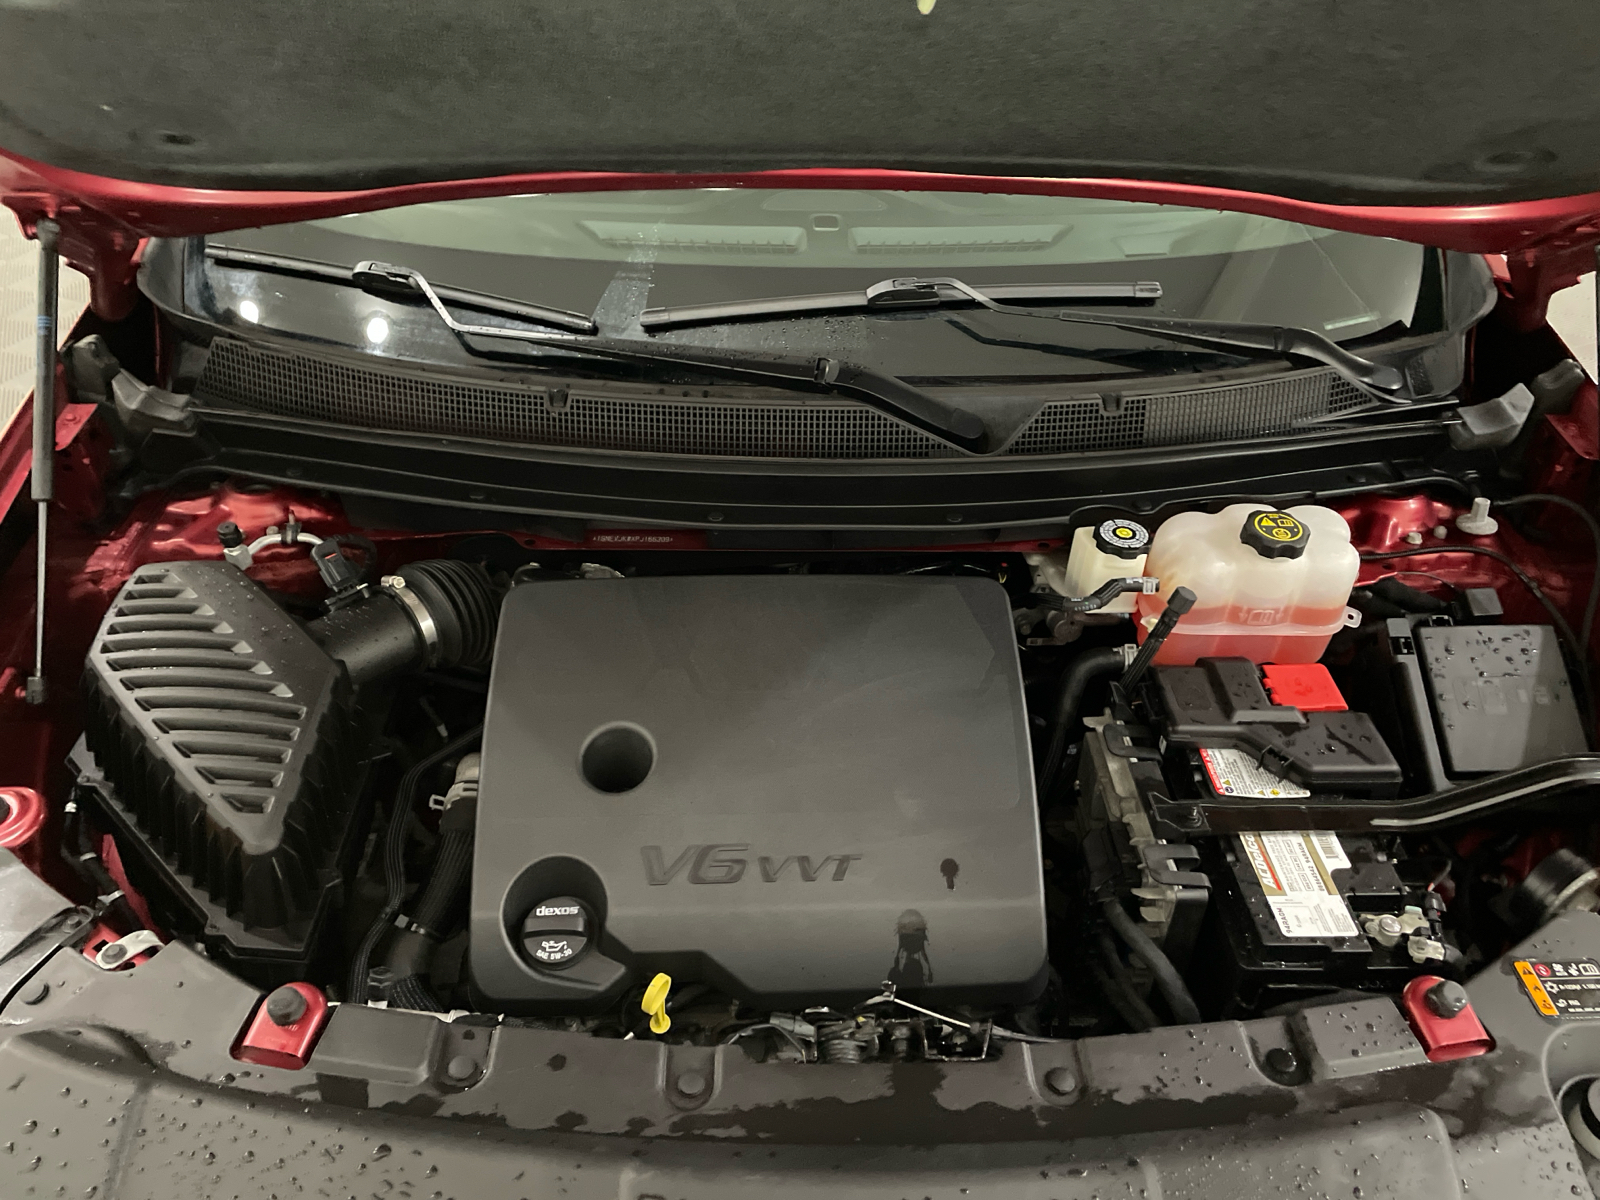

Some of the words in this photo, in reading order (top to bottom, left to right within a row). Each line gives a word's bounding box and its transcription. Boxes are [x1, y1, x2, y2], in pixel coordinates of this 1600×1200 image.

[640, 843, 750, 885] V6
[757, 854, 864, 882] VVT
[535, 905, 580, 917] dexos
[1276, 907, 1293, 934] 94RAGM
[536, 949, 550, 960] SAE
[550, 948, 573, 960] 5W-30
